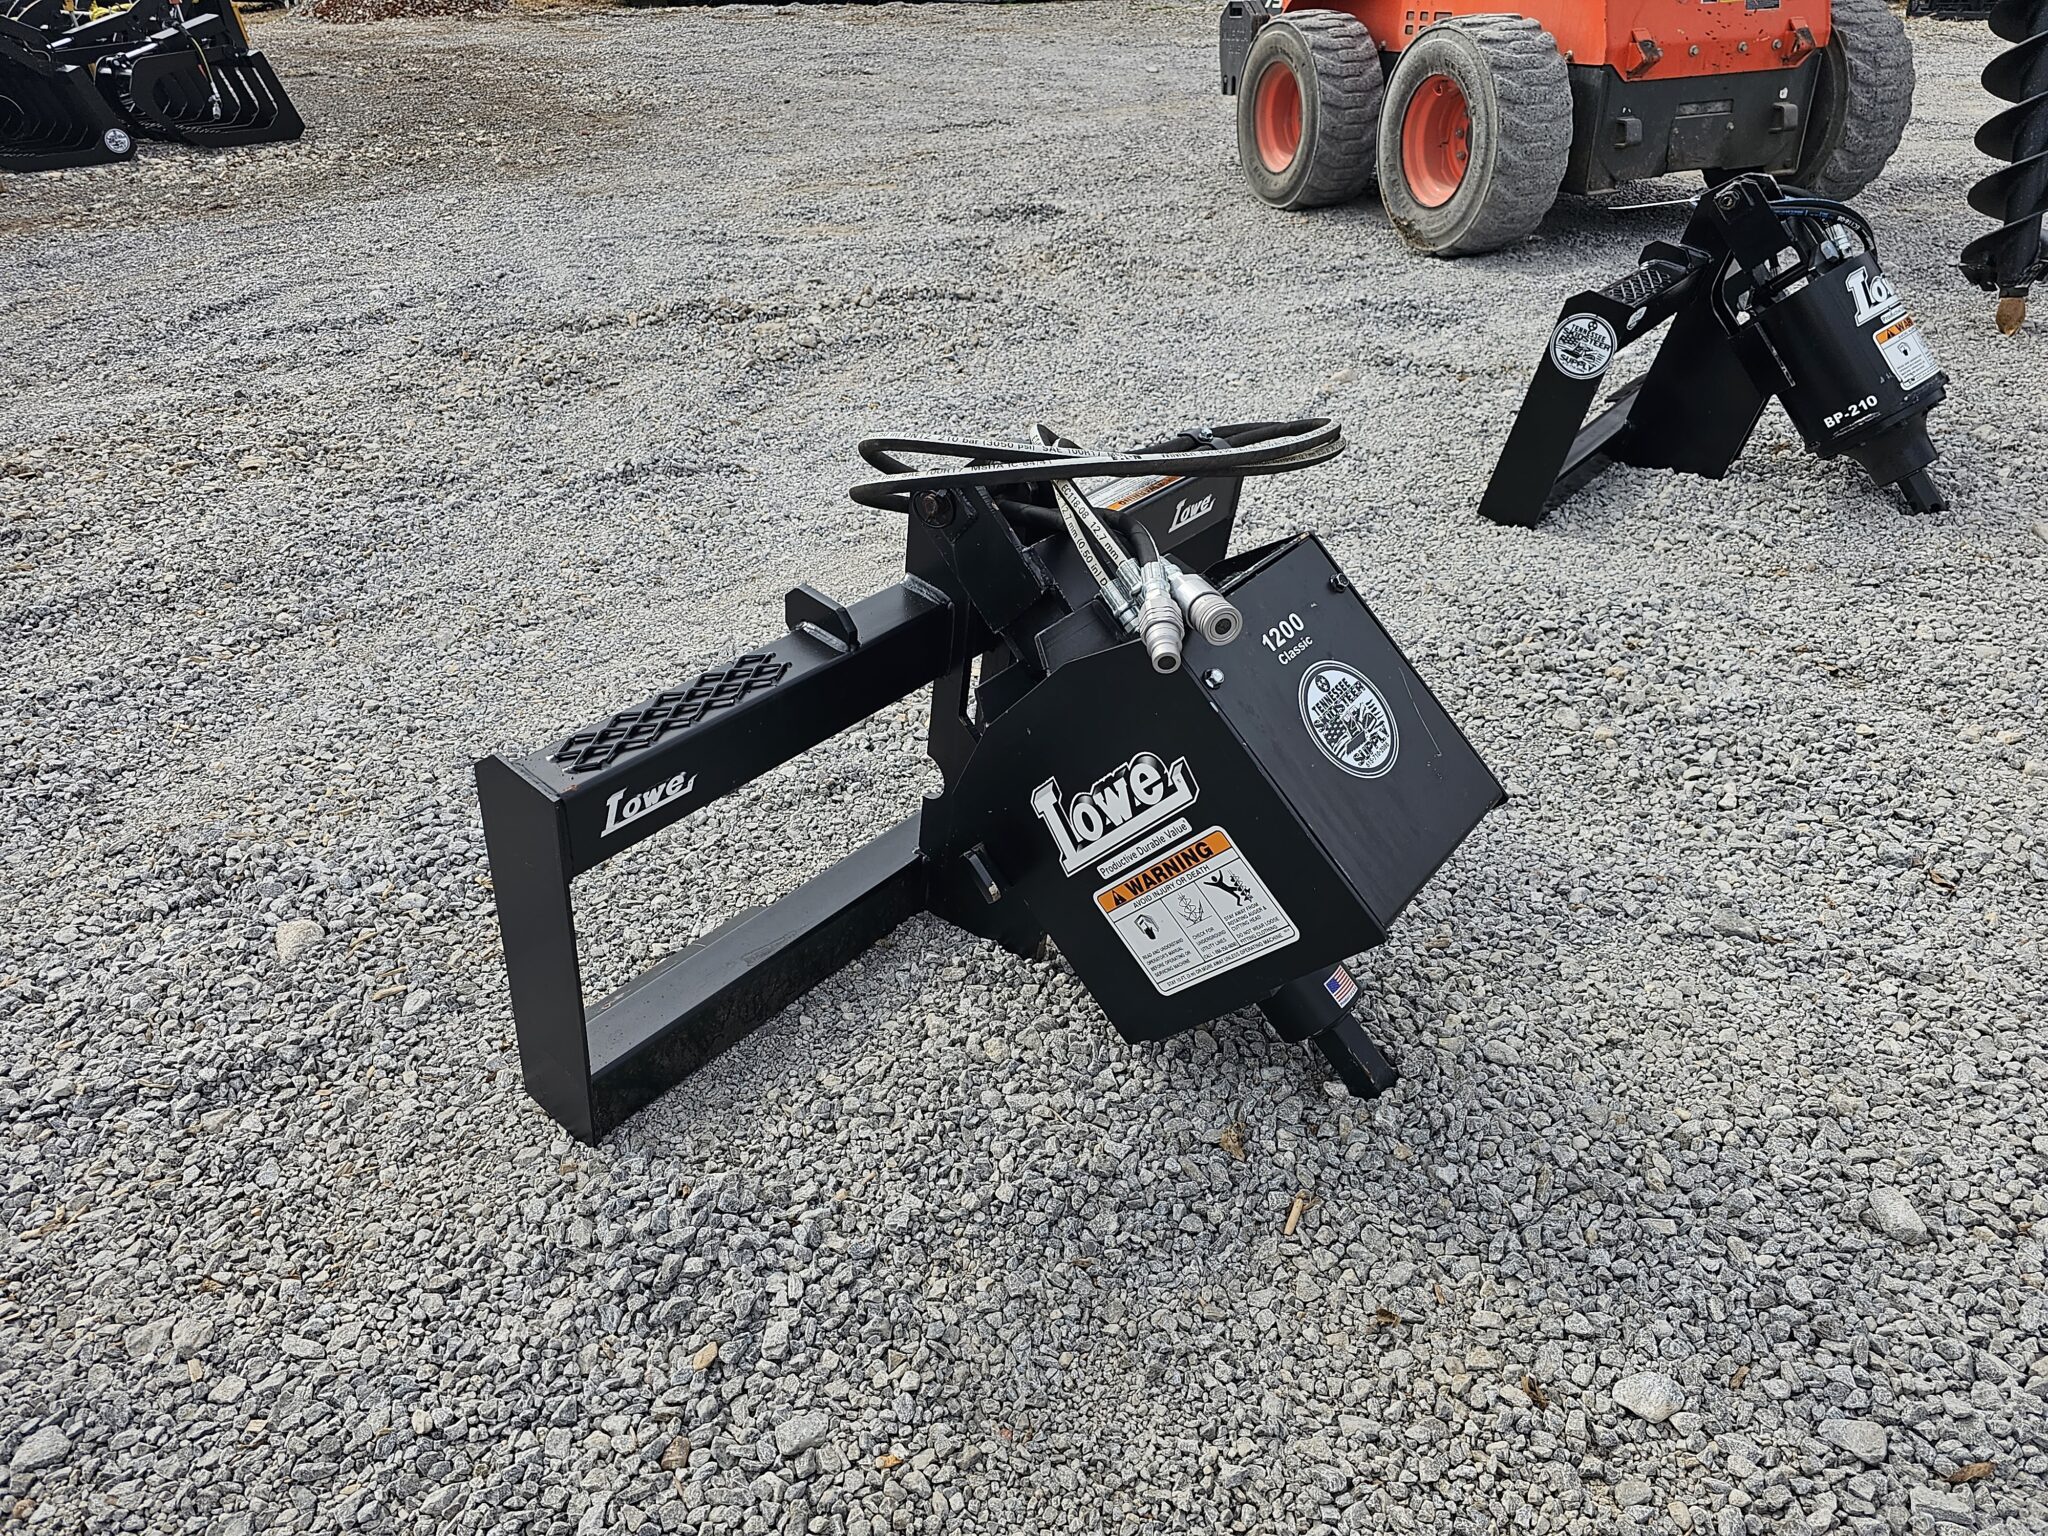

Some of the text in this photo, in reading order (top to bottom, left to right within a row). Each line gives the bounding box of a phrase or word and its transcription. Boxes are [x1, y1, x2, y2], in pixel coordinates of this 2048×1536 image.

[1563, 327, 1611, 352] SKIDSTEER
[1571, 324, 1607, 343] TENNESSEE
[1560, 354, 1597, 372] SUPPLY
[1823, 395, 1878, 428] BP-210
[983, 439, 1014, 449] (3050
[1017, 443, 1036, 451] psi)
[1042, 446, 1064, 454] SAE
[1061, 484, 1119, 560] EC118-08 12.7 mm
[1168, 493, 1216, 534] Lowe
[1060, 503, 1072, 521] 12.7
[1068, 522, 1079, 539] mm
[1076, 539, 1094, 564] (0.50
[1091, 563, 1102, 577] in)
[1262, 613, 1304, 652] 1200
[1277, 635, 1313, 665] Classic
[1311, 678, 1351, 716] TENNESSEE
[1314, 681, 1366, 733] SKIDSTEER
[1353, 721, 1390, 767] SUPPLY
[600, 771, 698, 838] Lowe
[1031, 751, 1199, 877] Lowe
[1100, 822, 1187, 877] Productive Durable Value
[1124, 840, 1213, 896] WARNING
[1132, 864, 1210, 908] AVOID INJURY OR DEATH
